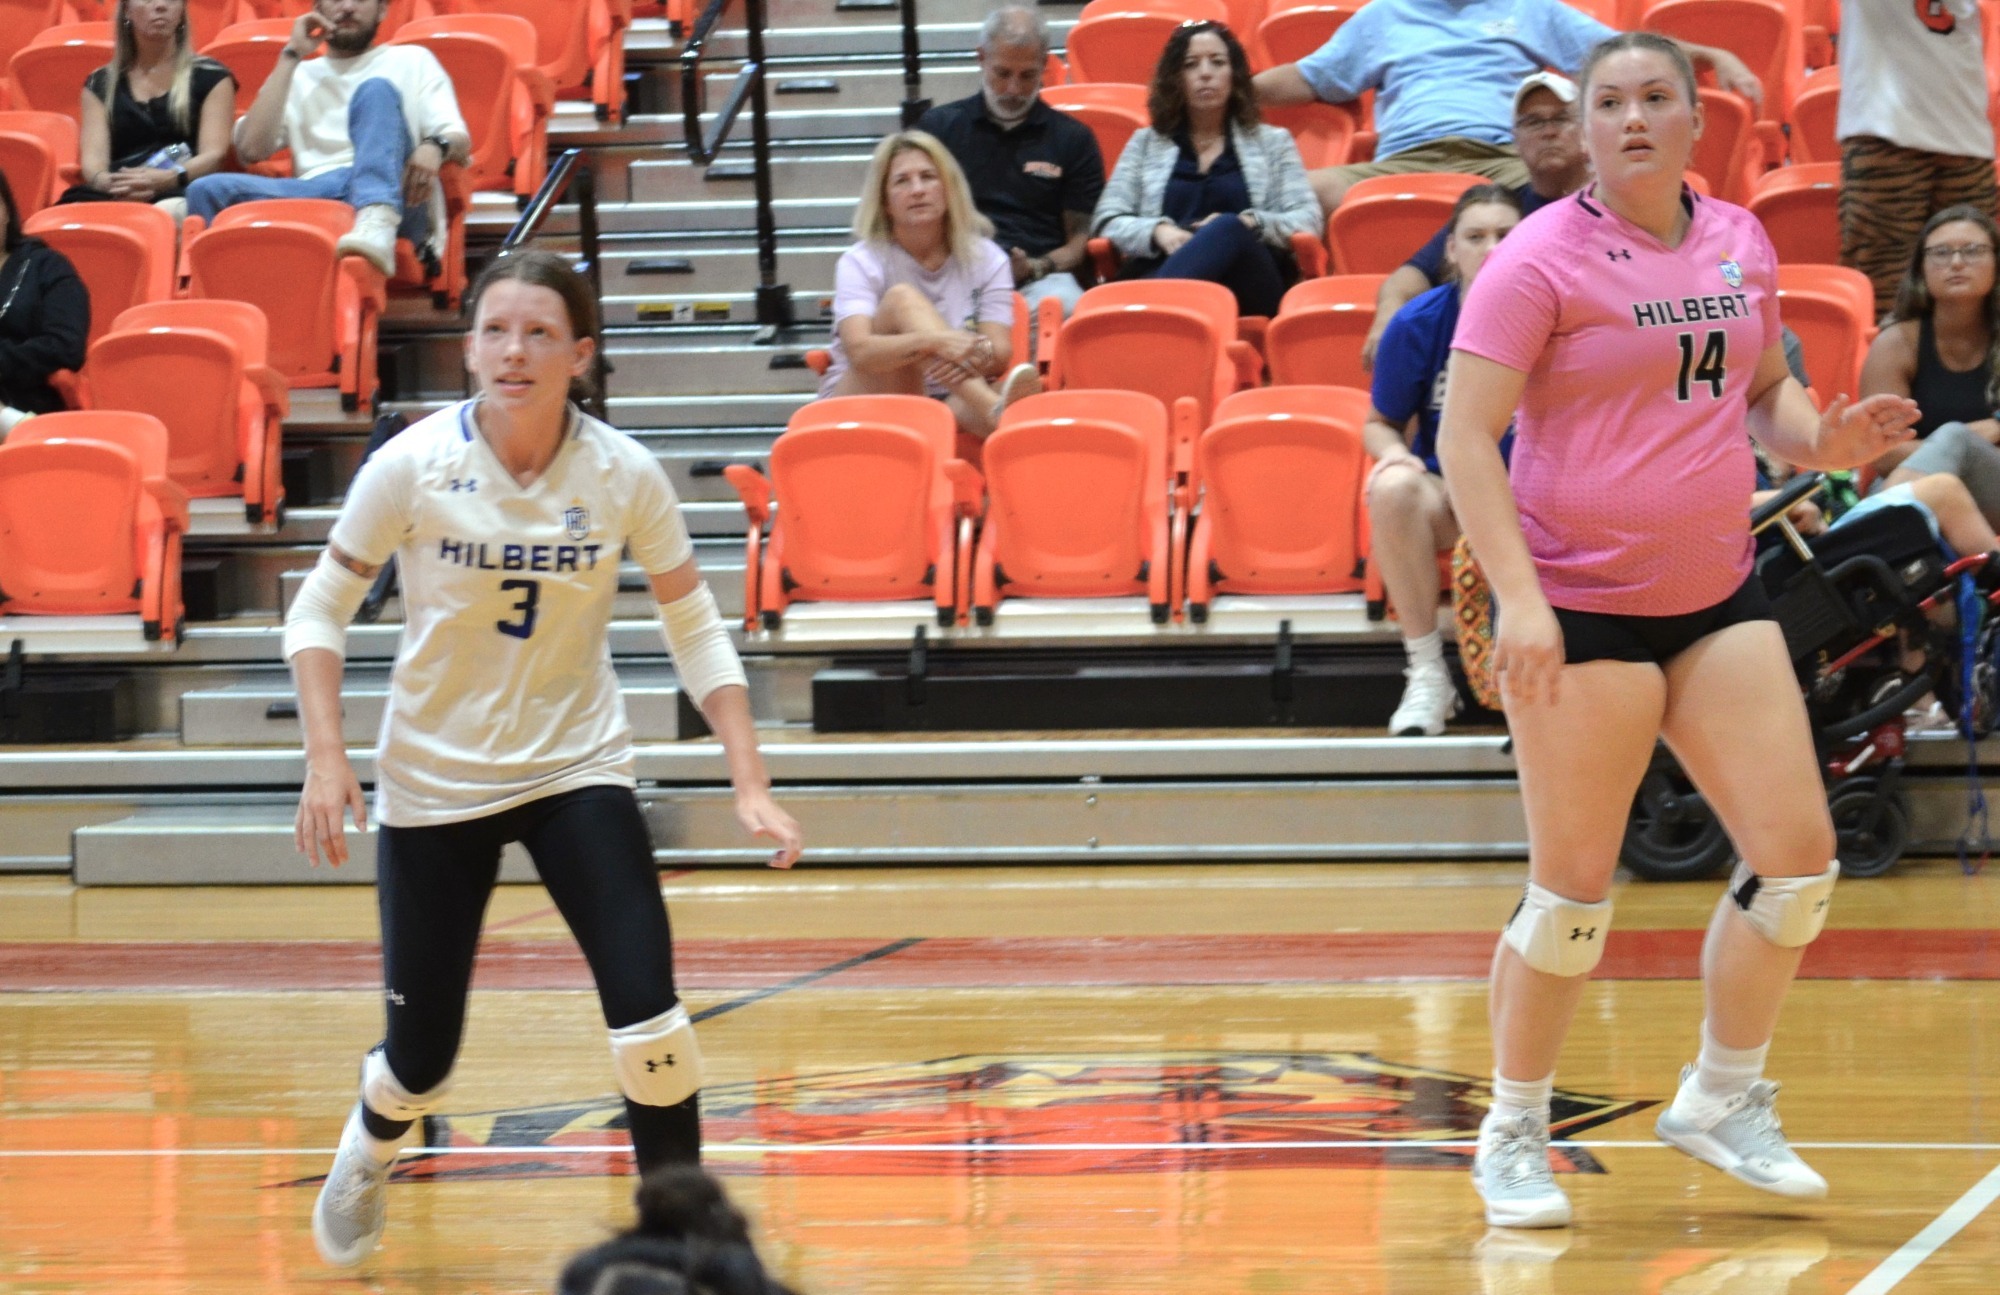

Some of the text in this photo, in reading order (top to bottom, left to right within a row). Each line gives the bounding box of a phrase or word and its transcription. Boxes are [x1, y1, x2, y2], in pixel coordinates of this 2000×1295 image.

[1633, 294, 1749, 327] HILBERT
[1677, 329, 1726, 402] 14
[440, 538, 602, 572] HILBERT
[497, 579, 539, 639] 3
